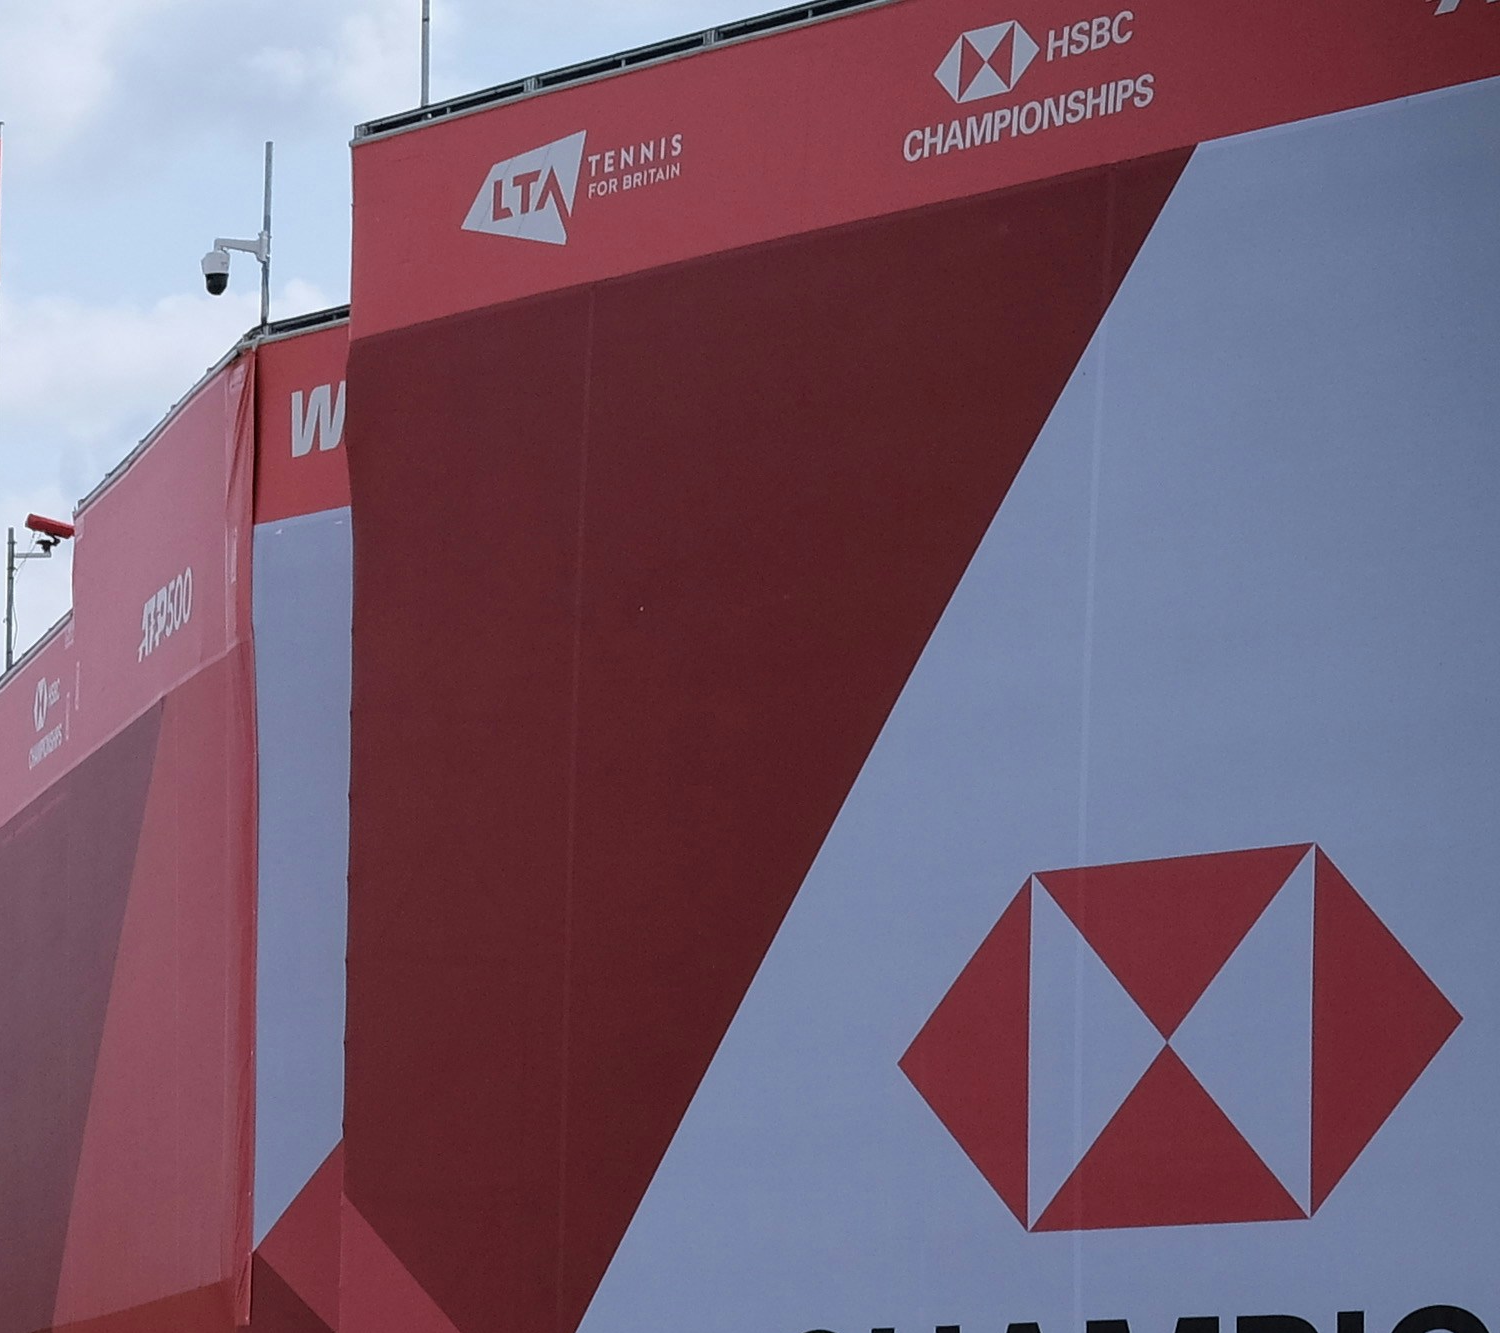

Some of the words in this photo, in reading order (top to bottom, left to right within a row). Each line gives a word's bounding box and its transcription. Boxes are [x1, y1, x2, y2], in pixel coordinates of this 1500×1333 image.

[1045, 10, 1134, 62] HSBC
[903, 73, 1155, 163] CHAMPIONSHIPS
[587, 134, 683, 177] TENNIS
[589, 179, 617, 199] FOR
[623, 163, 680, 191] BRITAIN
[492, 166, 570, 221] LTA
